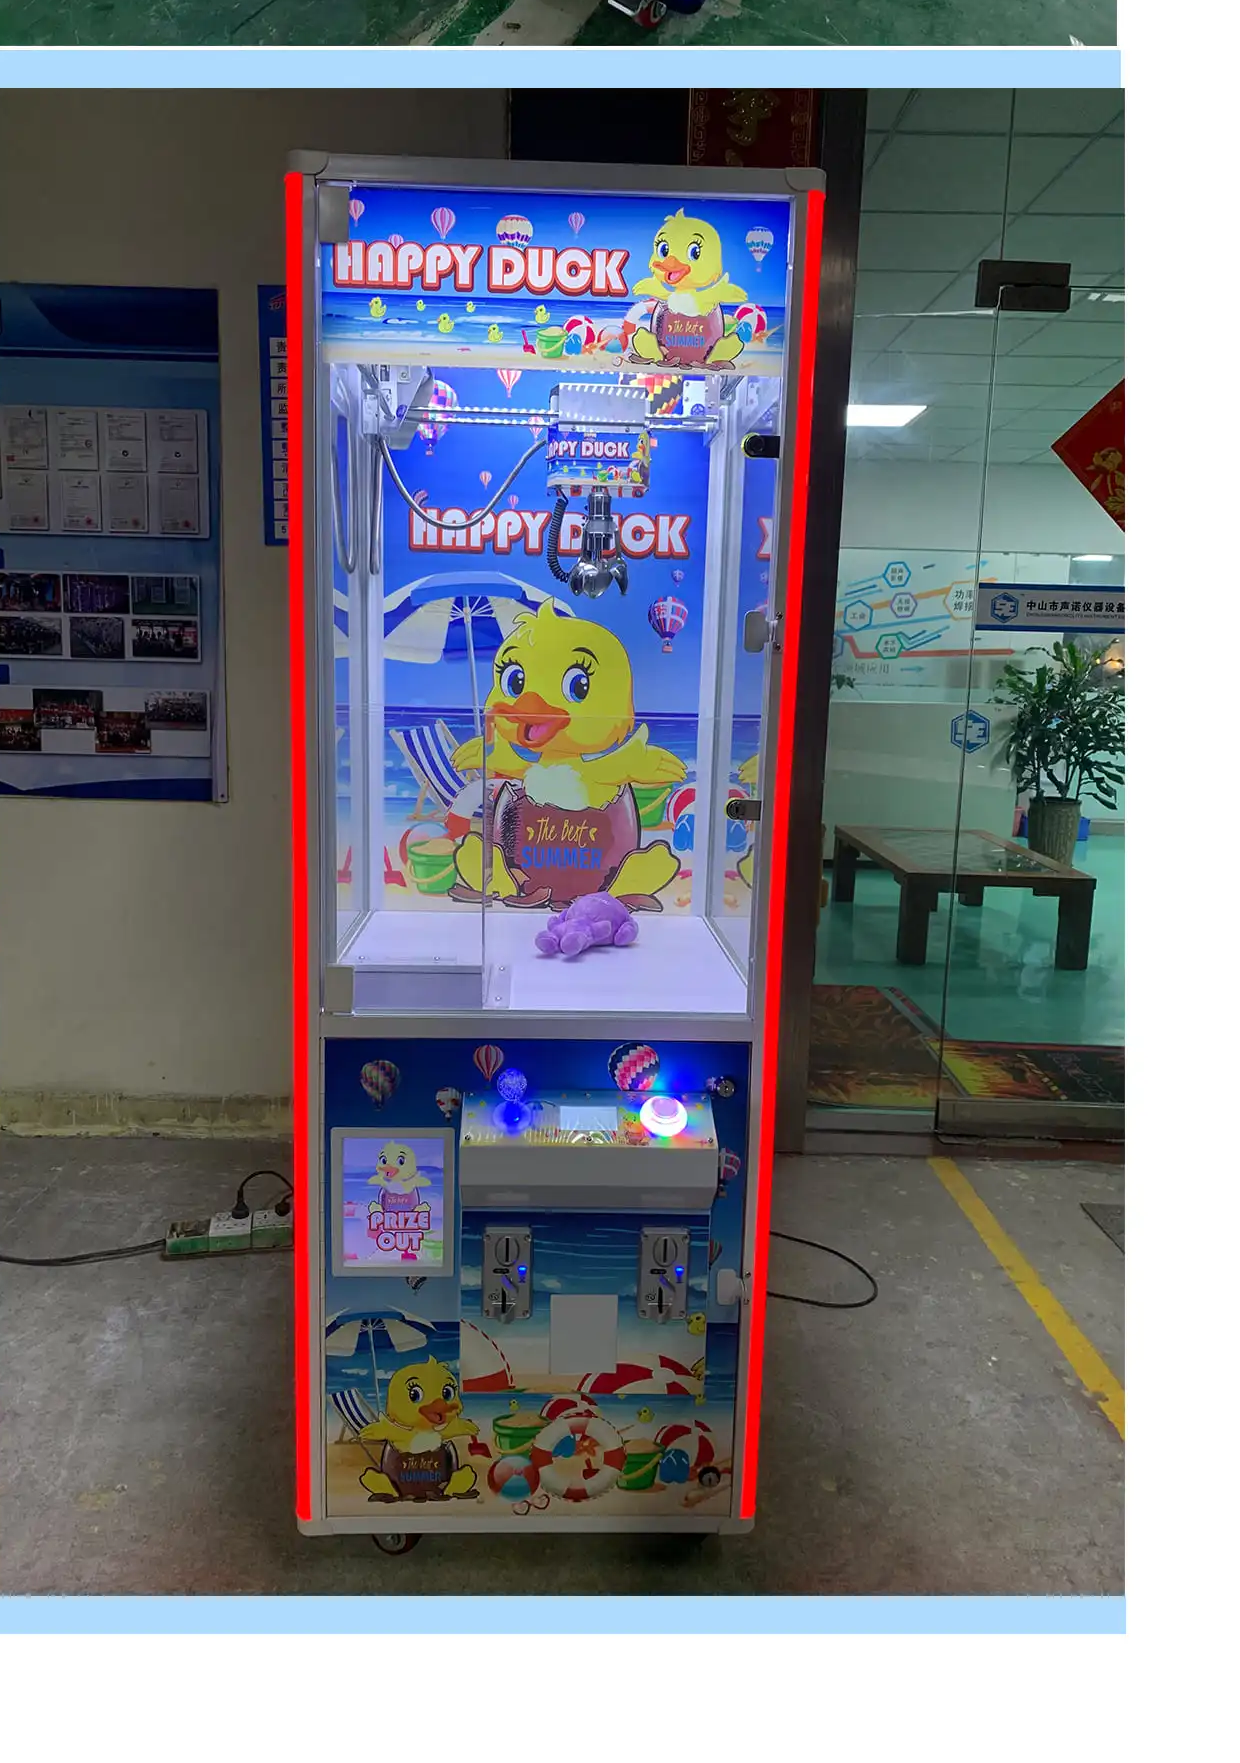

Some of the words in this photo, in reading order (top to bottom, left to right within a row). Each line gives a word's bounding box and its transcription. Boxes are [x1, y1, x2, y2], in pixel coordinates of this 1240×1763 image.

[333, 240, 483, 292] HAPPY
[487, 245, 630, 297] DUCK
[665, 335, 705, 348] SUMMER
[580, 440, 629, 458] DUCK
[409, 508, 551, 555] HAPPY
[556, 512, 691, 559] DCK
[536, 817, 558, 844] The
[521, 847, 603, 870] SUMMER
[369, 1211, 430, 1231] PRIZE
[376, 1232, 424, 1251] OUT
